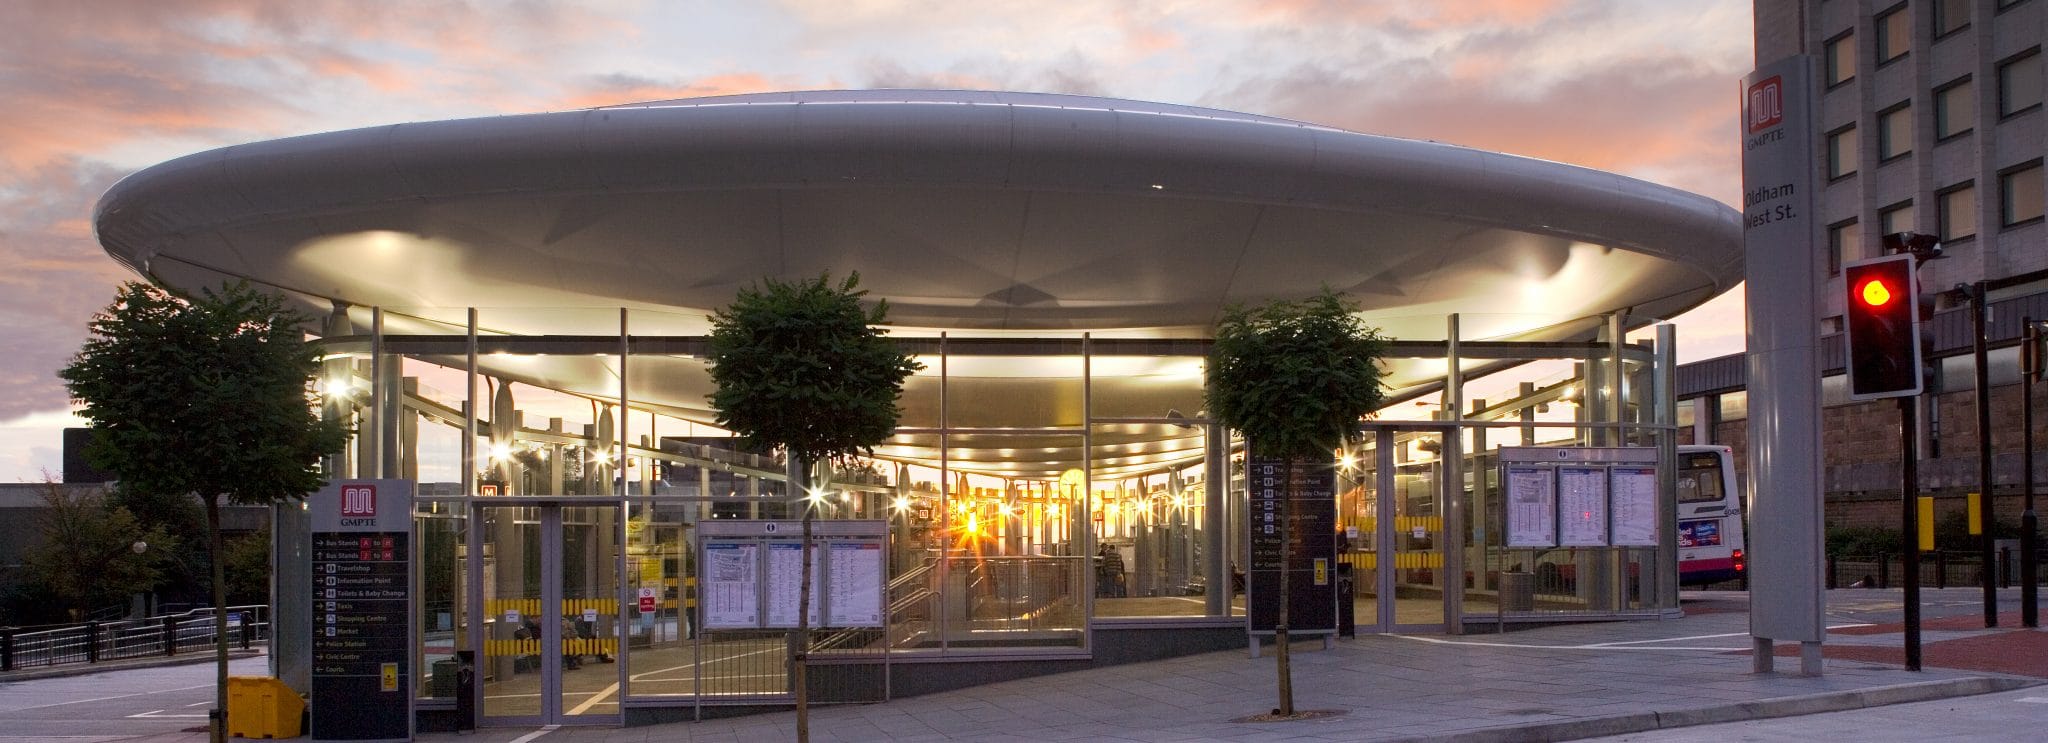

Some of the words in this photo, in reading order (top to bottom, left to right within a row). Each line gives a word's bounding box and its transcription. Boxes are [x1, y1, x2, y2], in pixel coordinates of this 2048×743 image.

[1748, 128, 1785, 151] GMPTE
[1746, 183, 1794, 208] Oldham
[1744, 208, 1772, 231] West
[1775, 203, 1797, 222] St.
